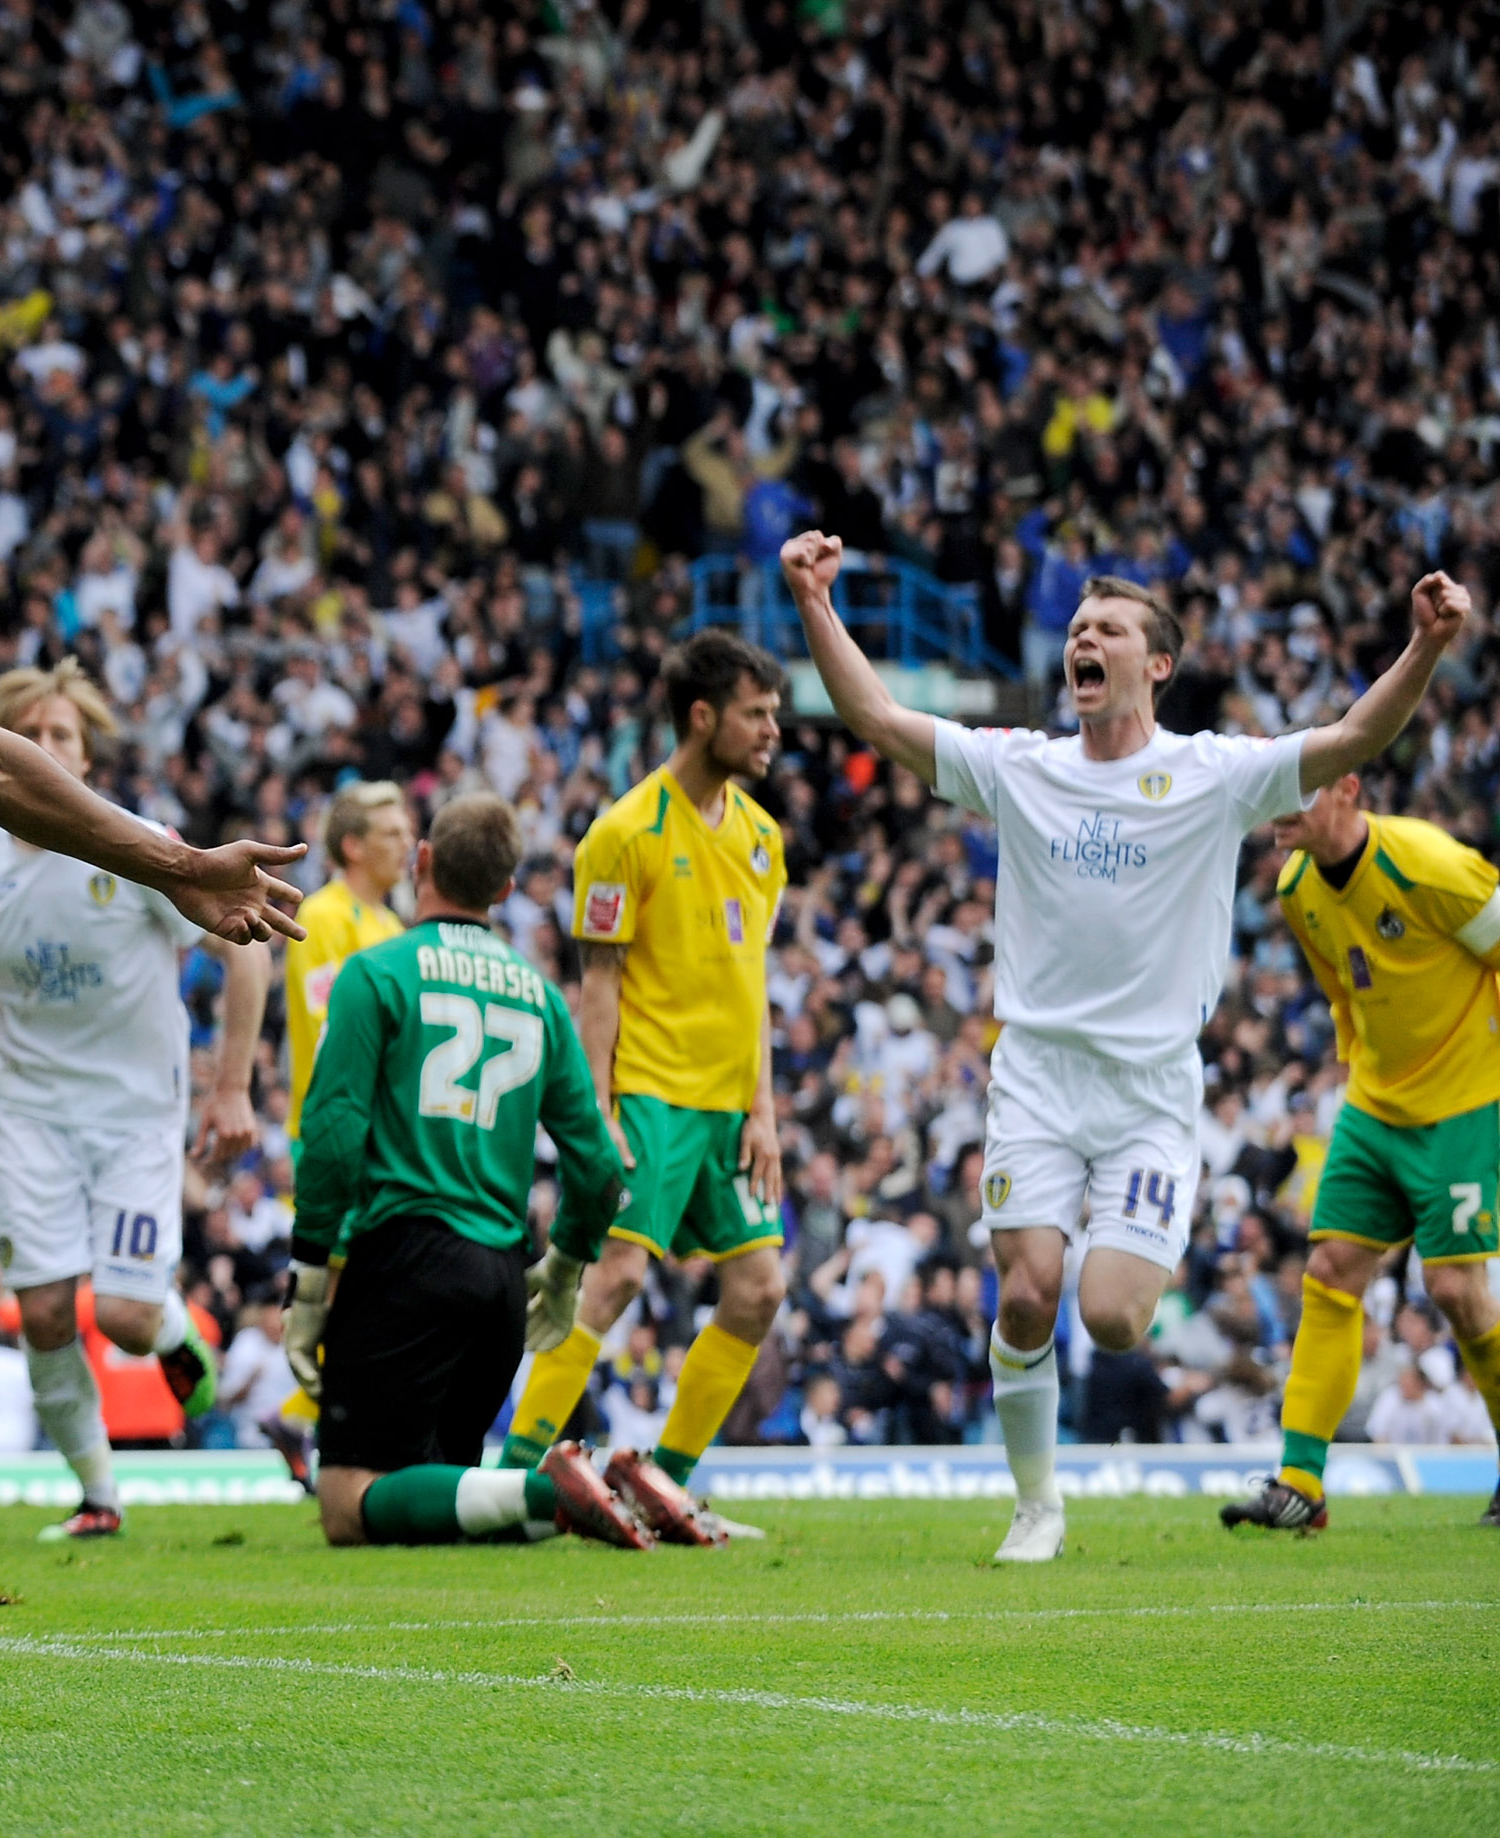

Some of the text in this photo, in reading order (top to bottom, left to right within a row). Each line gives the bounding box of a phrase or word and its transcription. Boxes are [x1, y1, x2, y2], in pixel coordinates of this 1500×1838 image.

[1076, 811, 1123, 840] NET
[1050, 839, 1147, 869] FLIGHTS
[418, 992, 545, 1131] 27
[1122, 1167, 1176, 1231] 14
[1449, 1182, 1483, 1235] 7
[111, 1209, 157, 1262] 10
